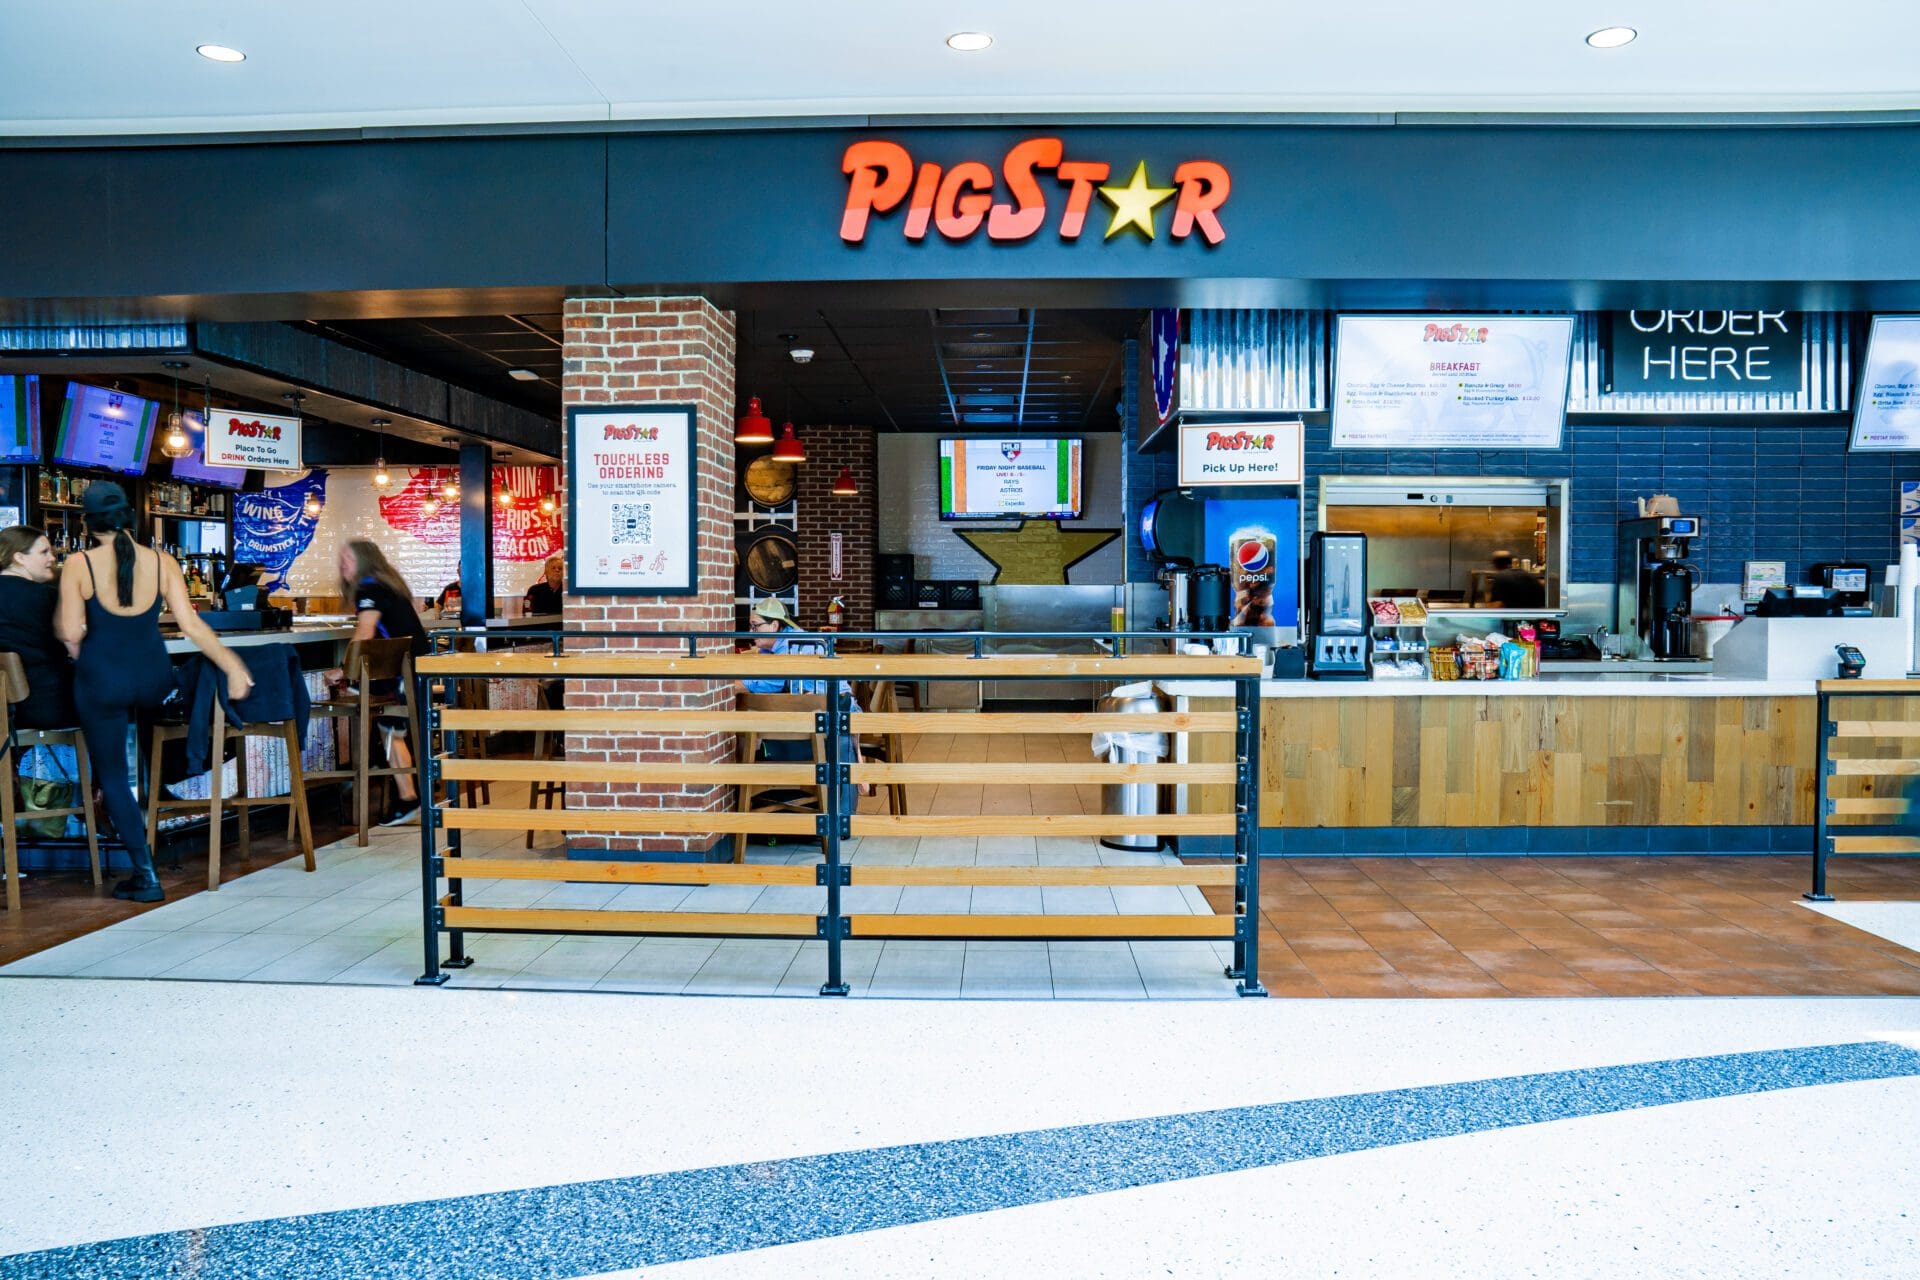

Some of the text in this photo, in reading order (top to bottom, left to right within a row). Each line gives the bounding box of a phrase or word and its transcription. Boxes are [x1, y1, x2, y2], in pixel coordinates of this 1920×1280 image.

[1630, 310, 1788, 335] ORDER
[1430, 362, 1481, 371] BREAKFAST
[1643, 346, 1772, 381] HERE
[235, 444, 255, 453] Place
[221, 453, 290, 465] DRINK Orders Here
[593, 453, 670, 465] TOUCHLESS
[599, 466, 664, 479] ORDERING
[1202, 463, 1278, 474] Pick Up Here!
[242, 501, 284, 520] WING
[506, 508, 542, 530] RIBS
[247, 536, 296, 553] DRUMSTICK
[499, 535, 550, 558] BACON
[1239, 573, 1268, 584] pepsi
